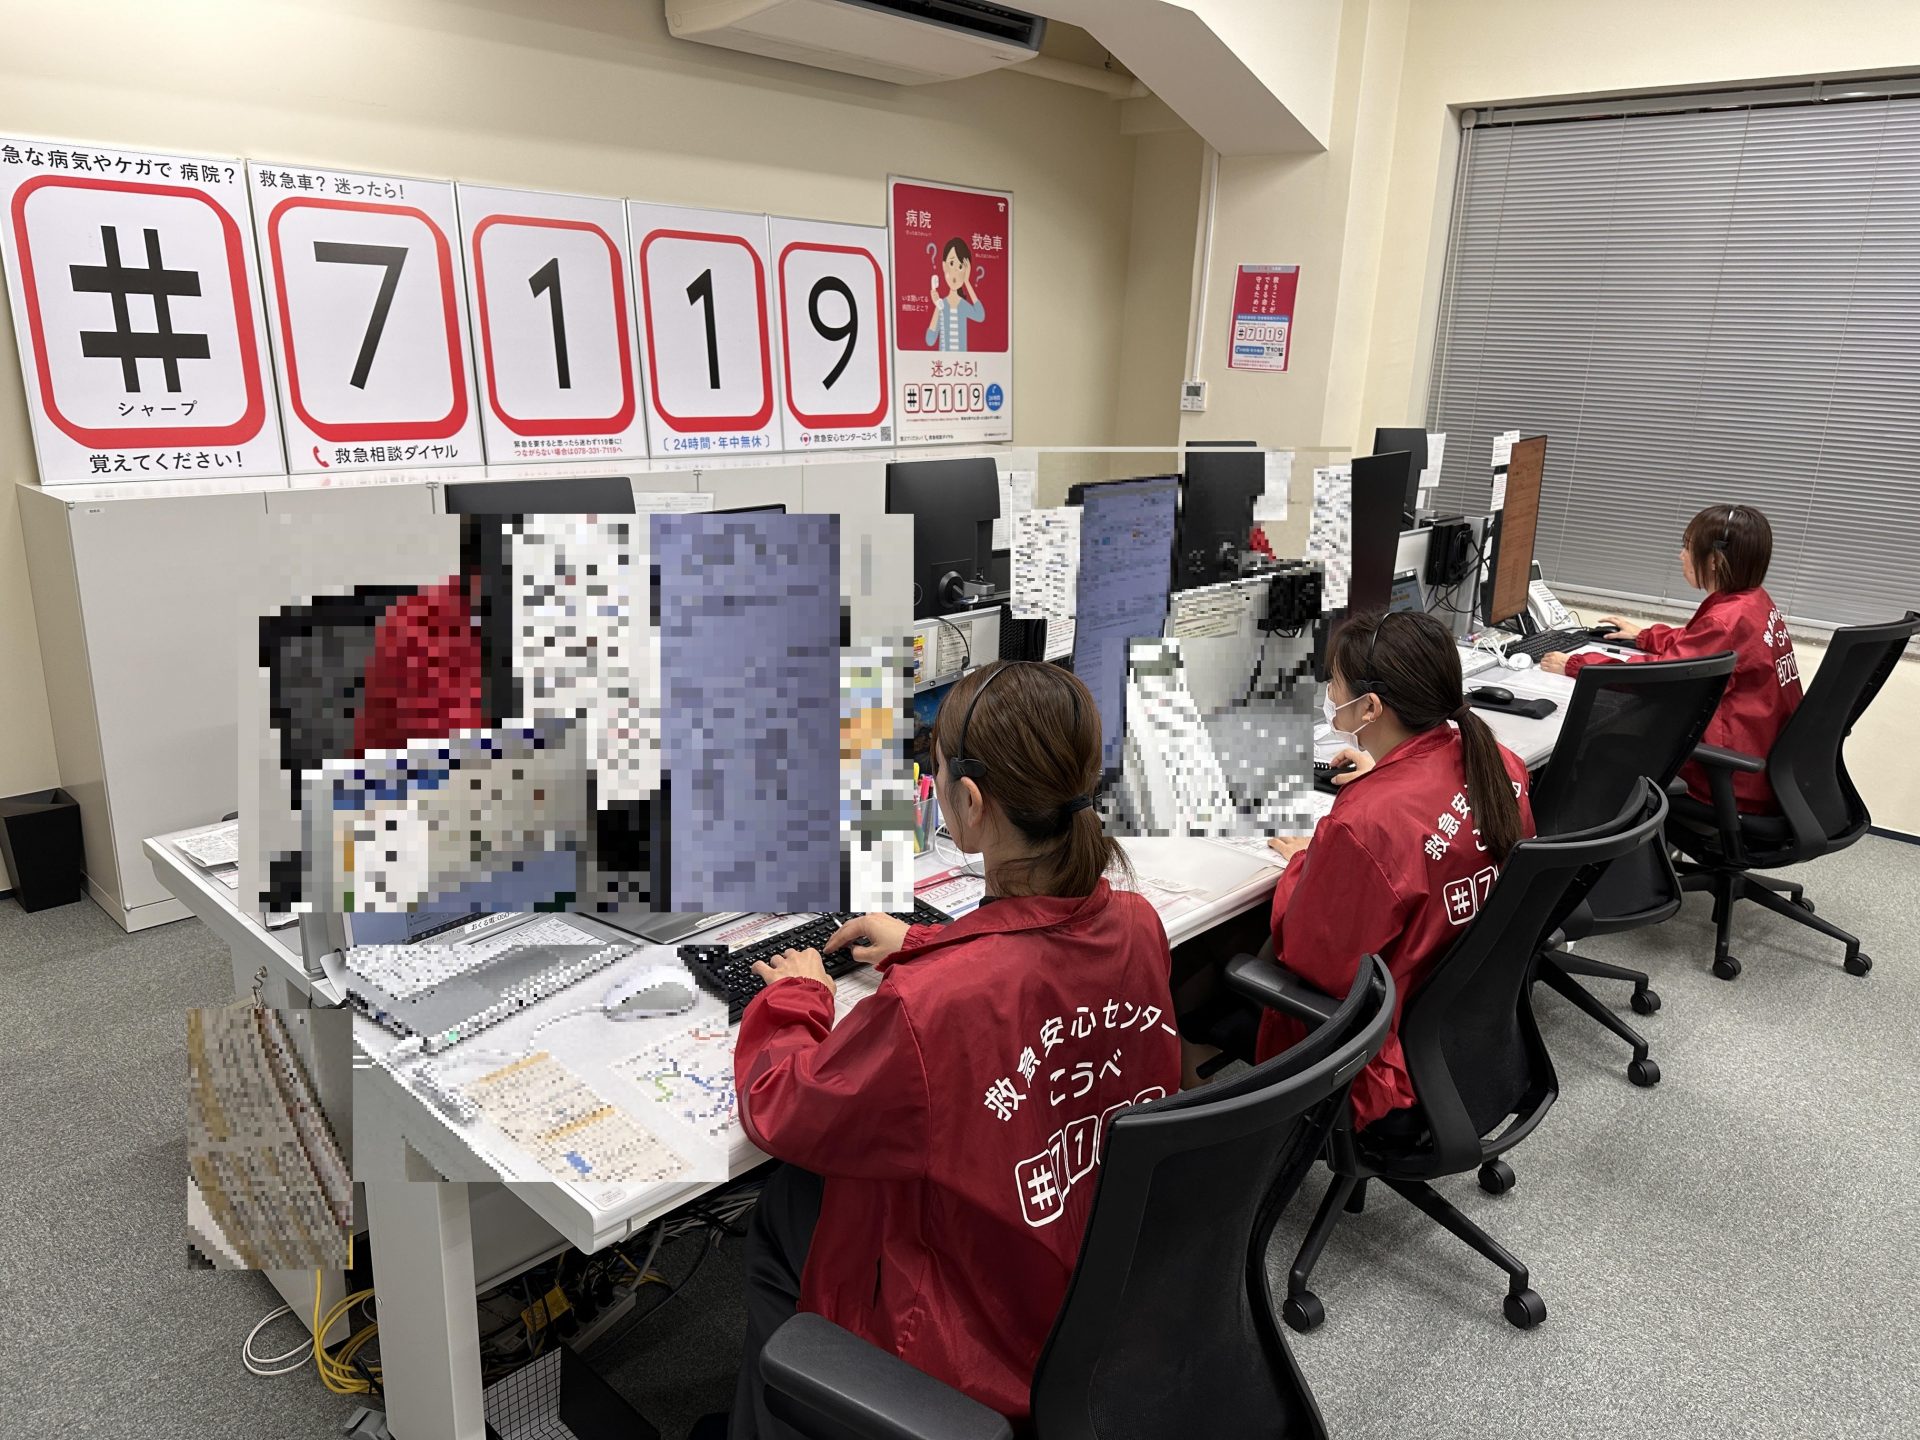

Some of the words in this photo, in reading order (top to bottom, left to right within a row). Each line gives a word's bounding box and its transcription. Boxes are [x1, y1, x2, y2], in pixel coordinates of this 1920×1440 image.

[2, 144, 172, 178] 急な病気やケガで
[181, 162, 235, 184] 病院？
[259, 170, 326, 192] 救急車？
[335, 178, 404, 199] 迷ったら!
[906, 209, 931, 229] 病院
[971, 232, 1003, 252] 救急車
[69, 225, 211, 393] #
[313, 241, 409, 390] 7
[528, 258, 571, 389] 1
[686, 268, 720, 389] 1
[808, 276, 858, 390] 9
[931, 359, 978, 378] 迷ったら!
[907, 387, 981, 408] #7119
[117, 400, 198, 417] シャープ
[813, 433, 877, 443] 救急安心センターこうべ
[89, 450, 243, 473] 覚えてください!
[335, 444, 459, 464] 救急相談ダイヤル
[984, 998, 1177, 1122] 救急安心センター
[1050, 1048, 1122, 1107] こうべ
